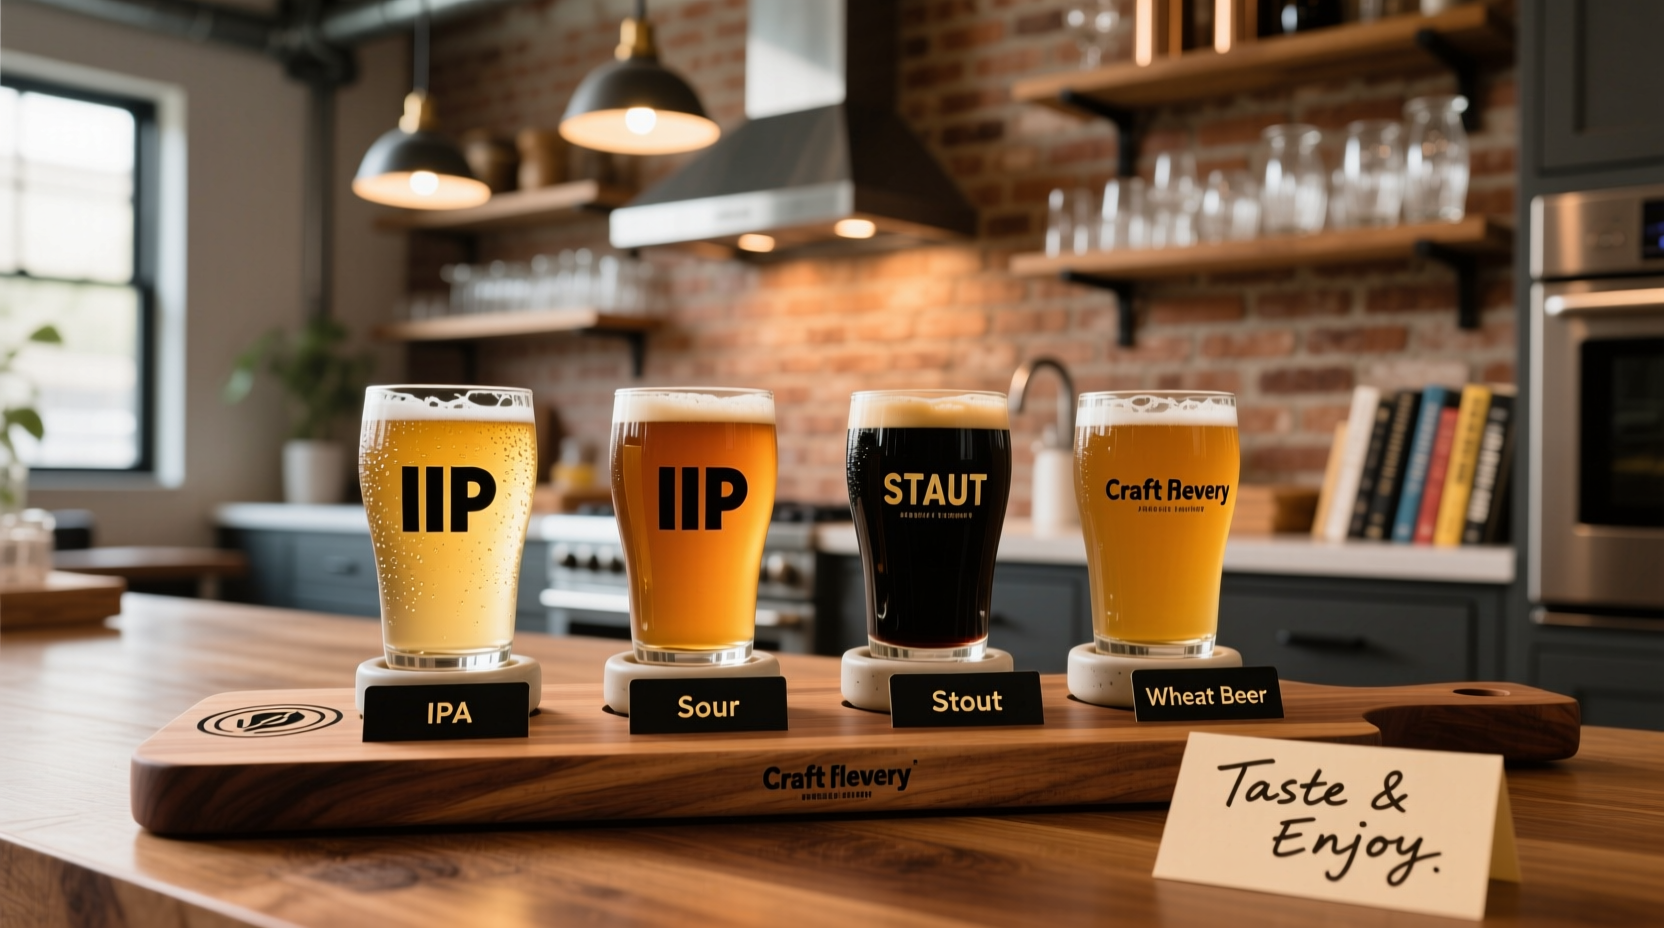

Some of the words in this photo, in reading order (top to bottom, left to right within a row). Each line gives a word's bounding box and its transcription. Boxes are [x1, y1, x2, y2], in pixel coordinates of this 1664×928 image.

[883, 472, 988, 506] STAUT
[1105, 478, 1163, 501] Craft
[677, 695, 740, 719] Sour
[932, 690, 1003, 712] Stout
[1145, 686, 1215, 706] Wheat
[1220, 685, 1267, 705] Beer
[427, 702, 473, 725] IPA
[763, 764, 826, 790] Craft
[1217, 758, 1348, 808] Taste
[1371, 769, 1408, 813] &
[1272, 817, 1442, 887] Enjoy.
